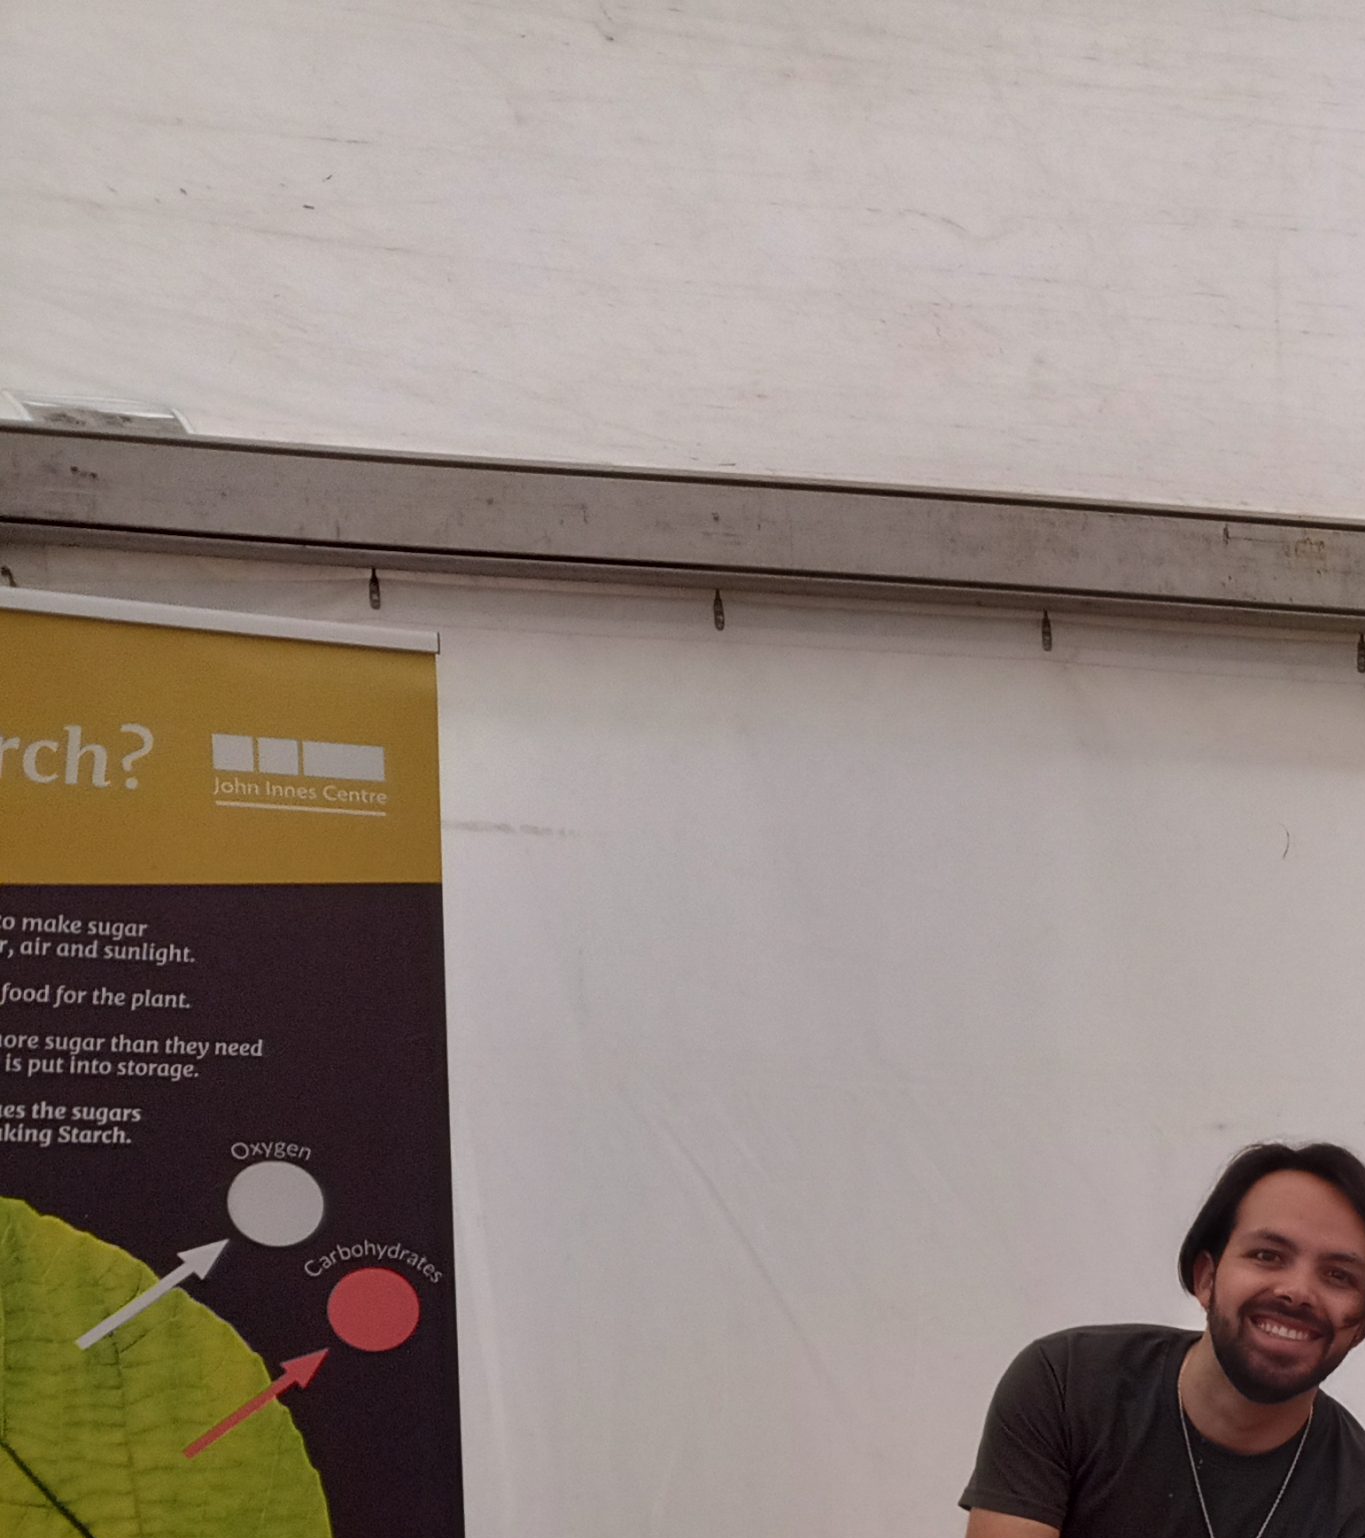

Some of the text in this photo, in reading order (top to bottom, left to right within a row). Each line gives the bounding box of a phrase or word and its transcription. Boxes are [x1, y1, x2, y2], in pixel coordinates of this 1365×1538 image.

[213, 777, 388, 804] John Innes Centre
[22, 914, 82, 934] make
[87, 920, 148, 940] sugar
[20, 937, 51, 956] air
[56, 940, 98, 958] and
[103, 943, 196, 966] sunlight.
[1, 982, 191, 1010] food for the plant.
[0, 1034, 264, 1060] ore sugar than they need
[5, 1053, 200, 1081] is put into storage.
[31, 1101, 66, 1120] the
[71, 1105, 142, 1125] sugars
[57, 1125, 132, 1144] Starch.
[230, 1141, 312, 1161] Oxygen
[304, 1240, 443, 1283] Carbohydrates
